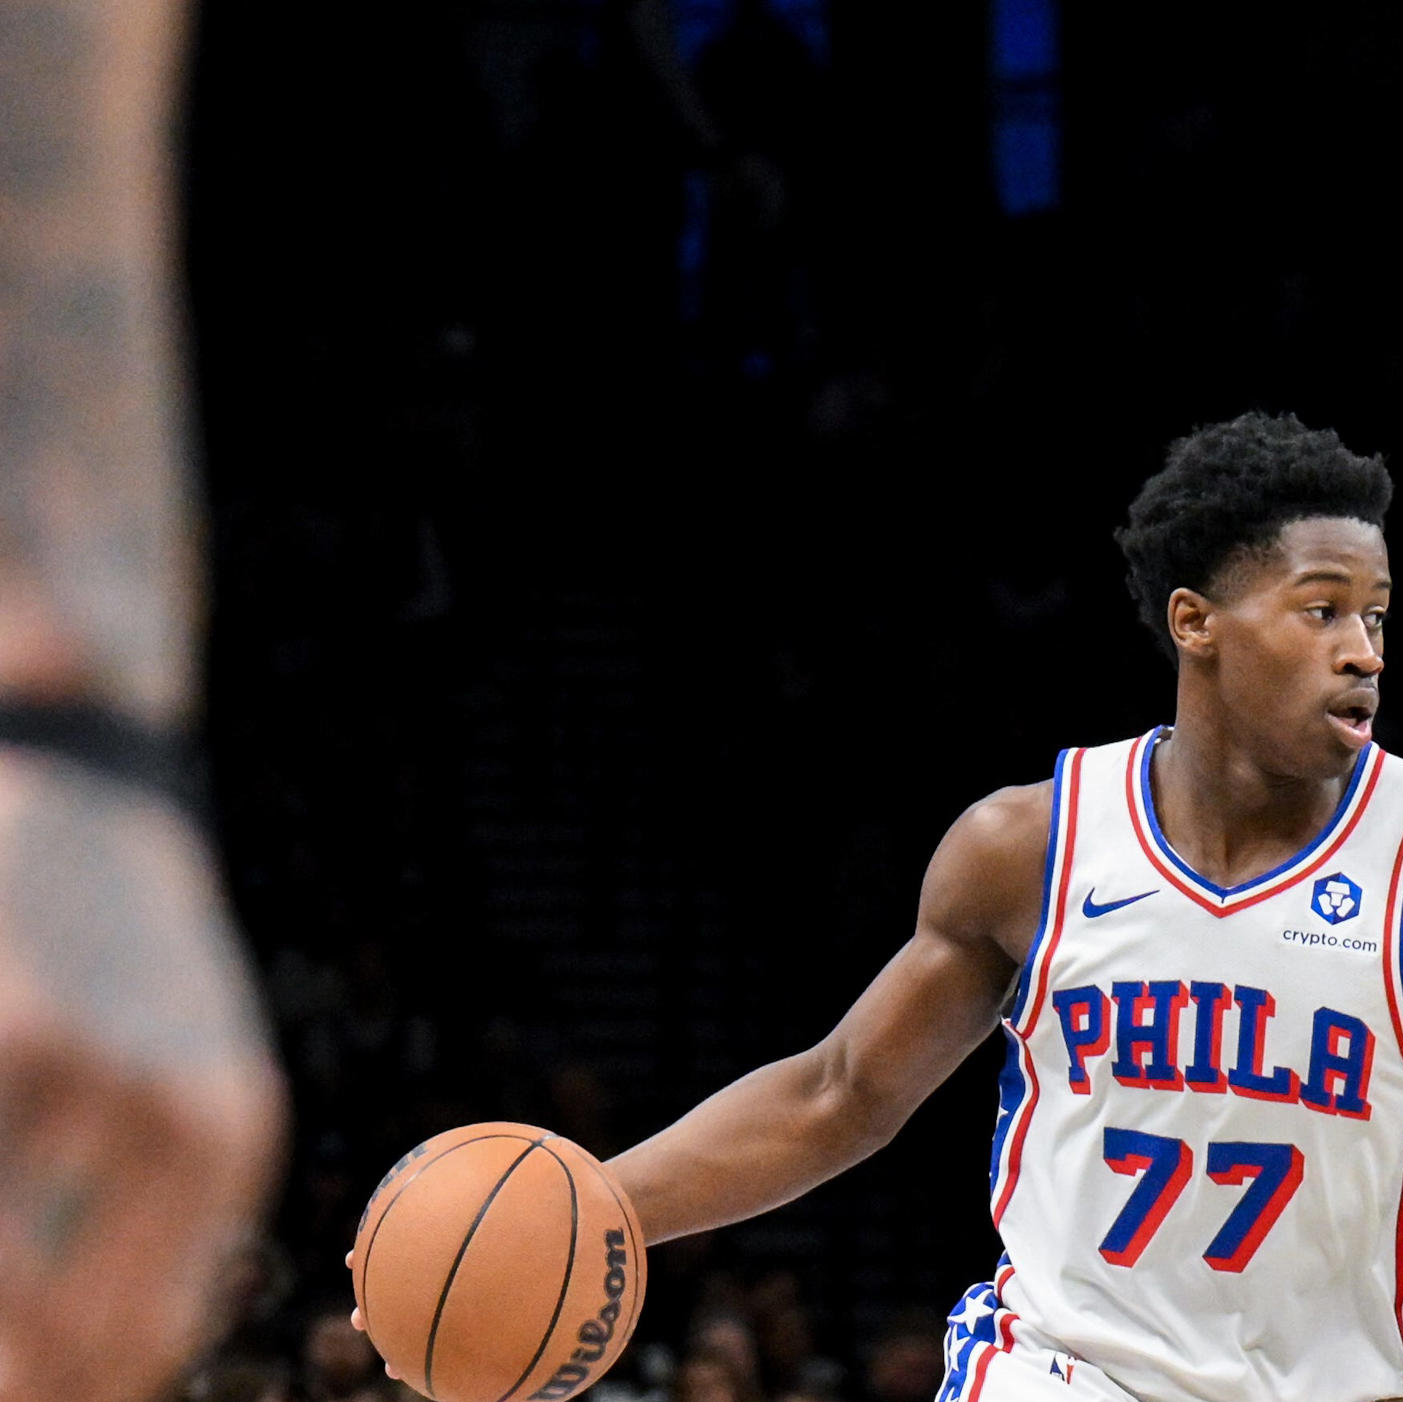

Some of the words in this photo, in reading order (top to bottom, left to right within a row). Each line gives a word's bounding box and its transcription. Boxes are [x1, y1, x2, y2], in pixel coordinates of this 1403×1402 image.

[1283, 929, 1378, 953] crypto.com
[1052, 980, 1376, 1121] PHILA
[1098, 1126, 1305, 1273] 77
[526, 1226, 628, 1402] Wilson
